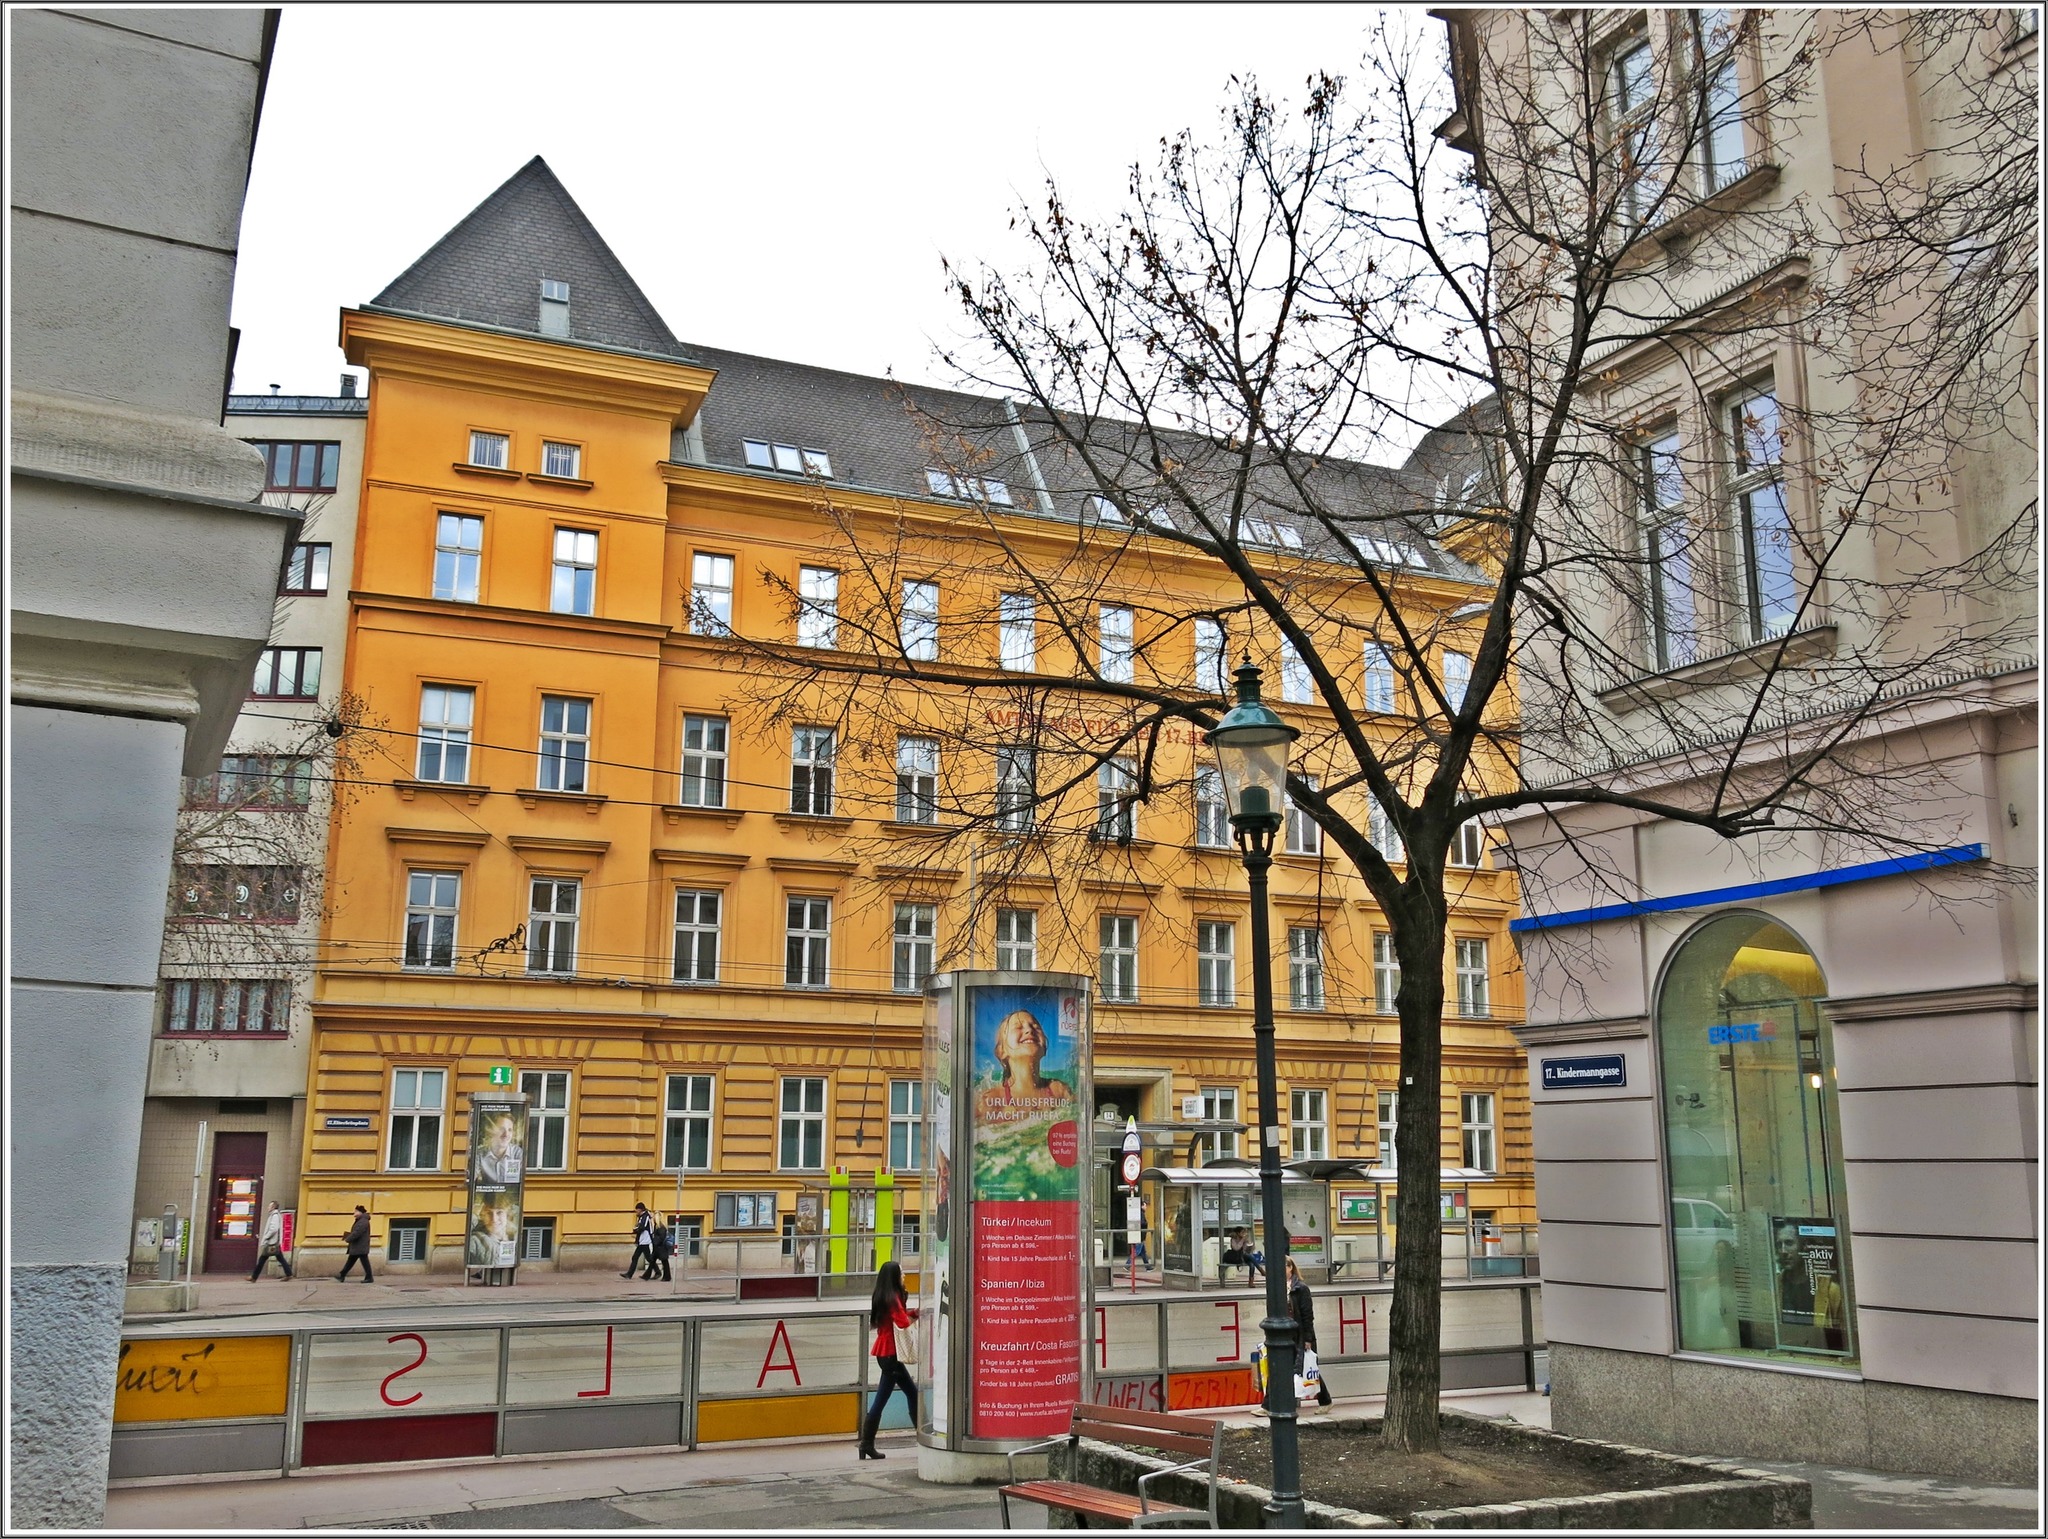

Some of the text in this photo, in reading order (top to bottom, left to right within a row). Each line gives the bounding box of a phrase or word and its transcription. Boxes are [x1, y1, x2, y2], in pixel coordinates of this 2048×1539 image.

[1126, 723, 1161, 741] EN
[1708, 1023, 1760, 1045] ERSTE
[1556, 1067, 1620, 1079] Kindermanngasse
[985, 1097, 1070, 1107] URLAUBSFREUDE
[985, 1111, 1025, 1121] MACHT
[981, 1217, 1010, 1226] Türkei
[1017, 1218, 1052, 1226] Incekum
[1809, 1249, 1833, 1260] aktiv
[1807, 1258, 1816, 1296] dynamisch
[981, 1279, 1019, 1290] Spanien
[1026, 1280, 1045, 1288] Ibiza
[980, 1342, 1029, 1351] Kreuzfahrt
[1036, 1341, 1057, 1351] Costa
[1056, 1372, 1079, 1385] GRATIS
